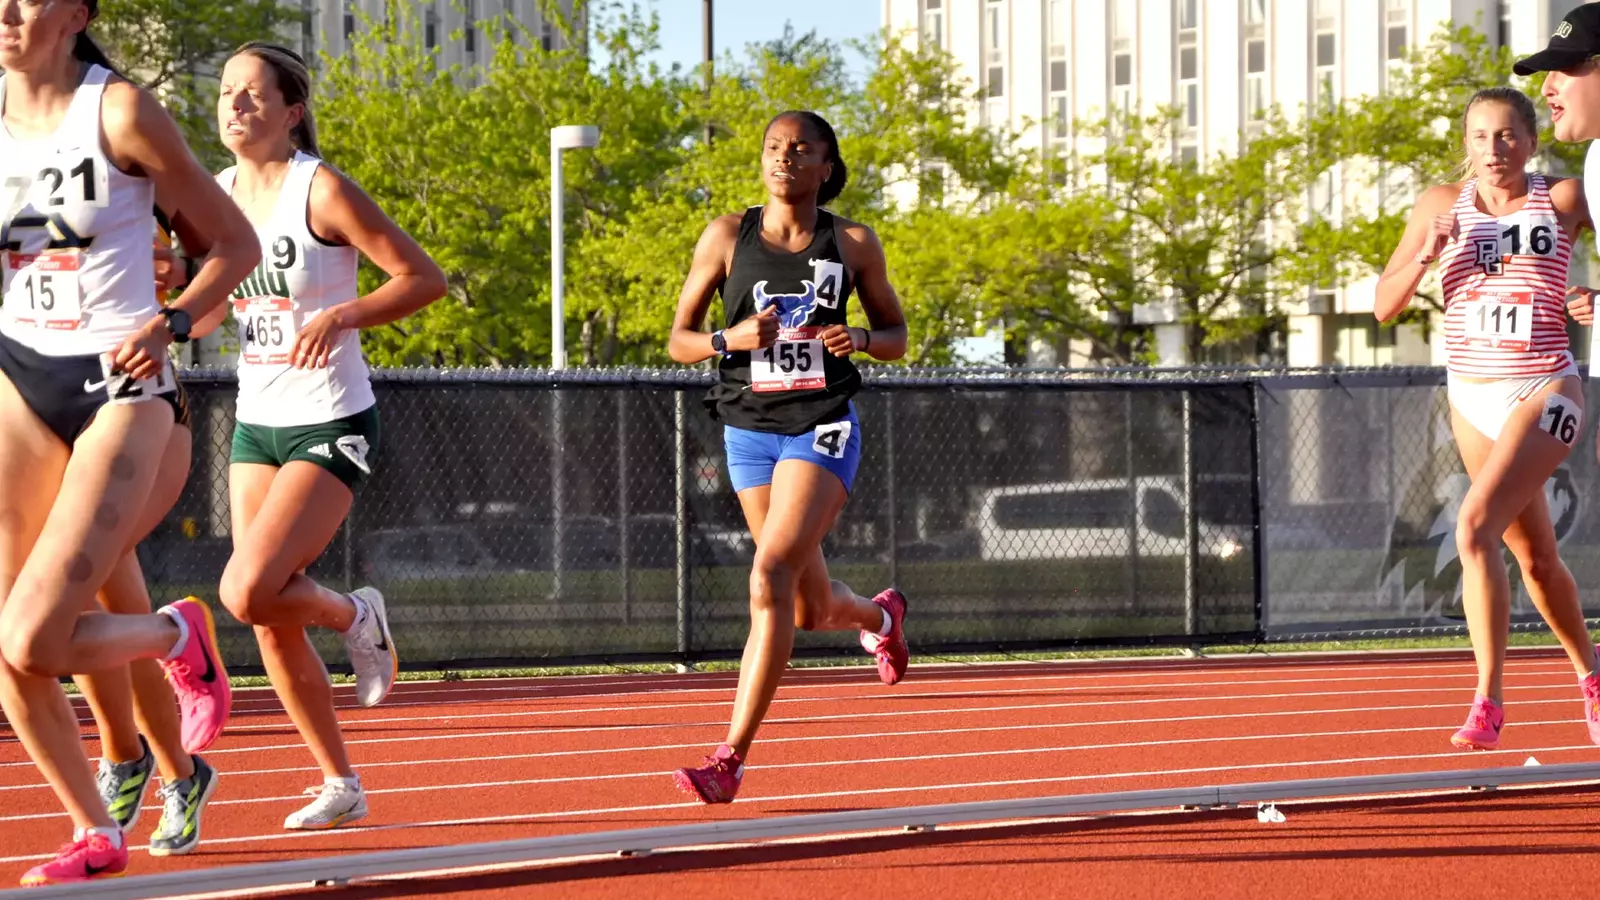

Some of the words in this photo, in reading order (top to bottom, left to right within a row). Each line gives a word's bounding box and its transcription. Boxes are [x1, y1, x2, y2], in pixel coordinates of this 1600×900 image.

[37, 157, 96, 206] 21
[1502, 224, 1553, 255] 16
[25, 274, 55, 311] 15
[816, 274, 836, 307] 4
[246, 315, 283, 347] 465
[1477, 305, 1518, 334] 111
[763, 342, 812, 374] 155
[1547, 404, 1578, 445] 16
[816, 429, 842, 456] 4
